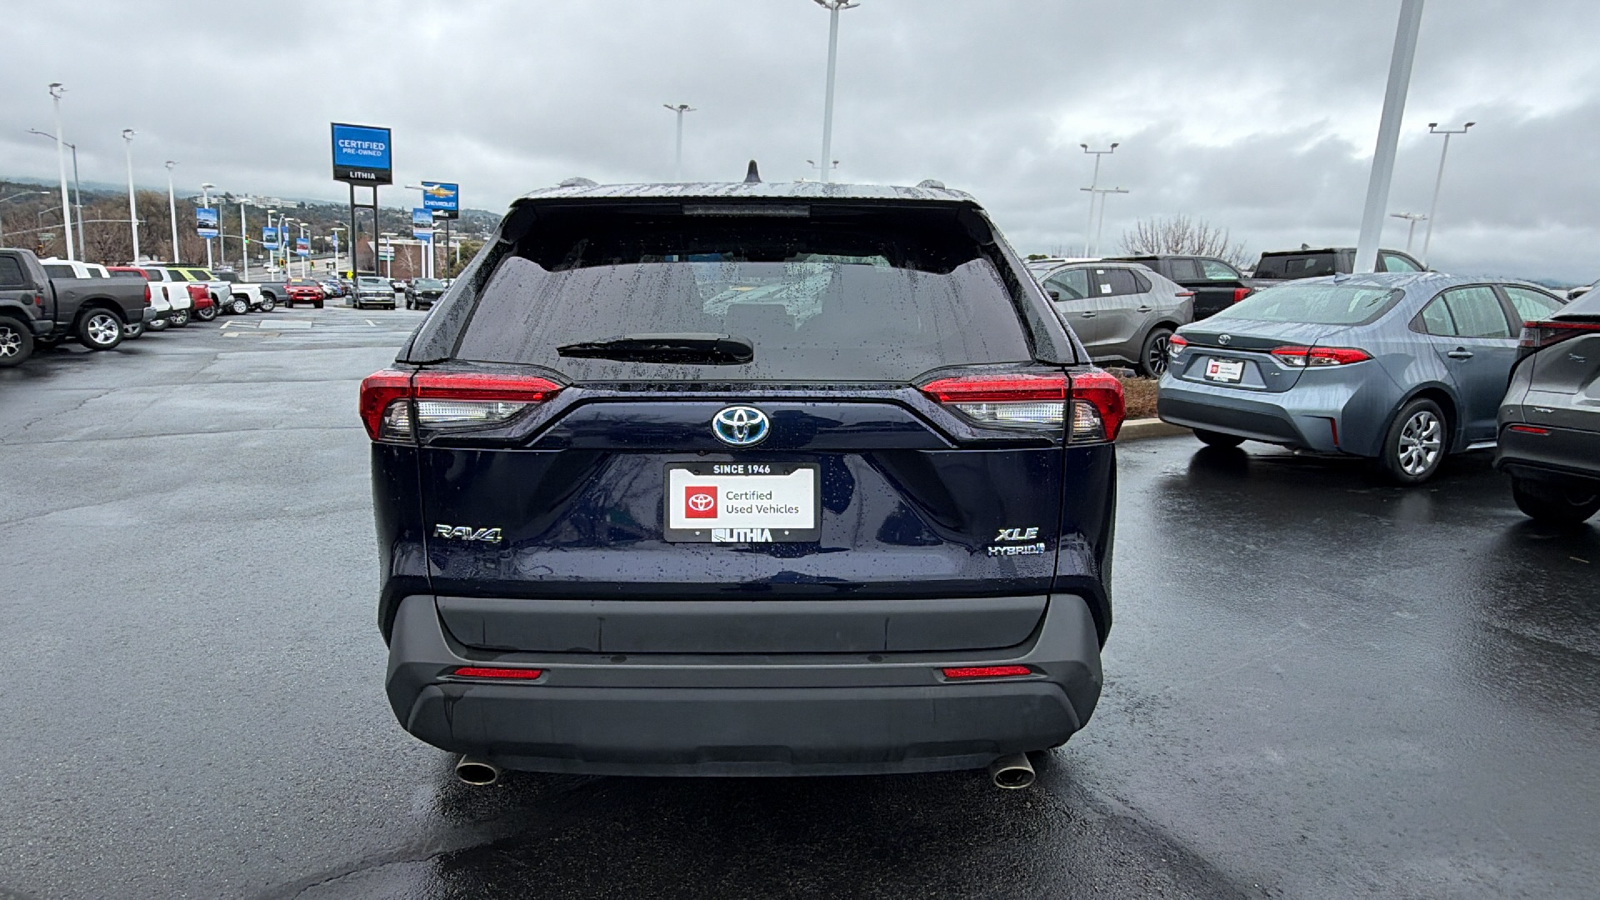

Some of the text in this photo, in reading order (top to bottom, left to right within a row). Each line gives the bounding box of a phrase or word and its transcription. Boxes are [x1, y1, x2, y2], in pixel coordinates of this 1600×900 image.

[338, 139, 386, 151] CERTIFIED
[342, 148, 382, 157] PRE-OWNED
[349, 171, 376, 180] LITHIA
[424, 200, 456, 208] CHEVROLET
[713, 464, 771, 474] SINCE 1946
[725, 490, 773, 501] Certified
[725, 504, 800, 514] Used Vehicles
[433, 523, 503, 543] RAV4
[725, 528, 773, 542] LITHIA
[994, 527, 1039, 541] XLE
[987, 544, 1037, 556] HYBRID
